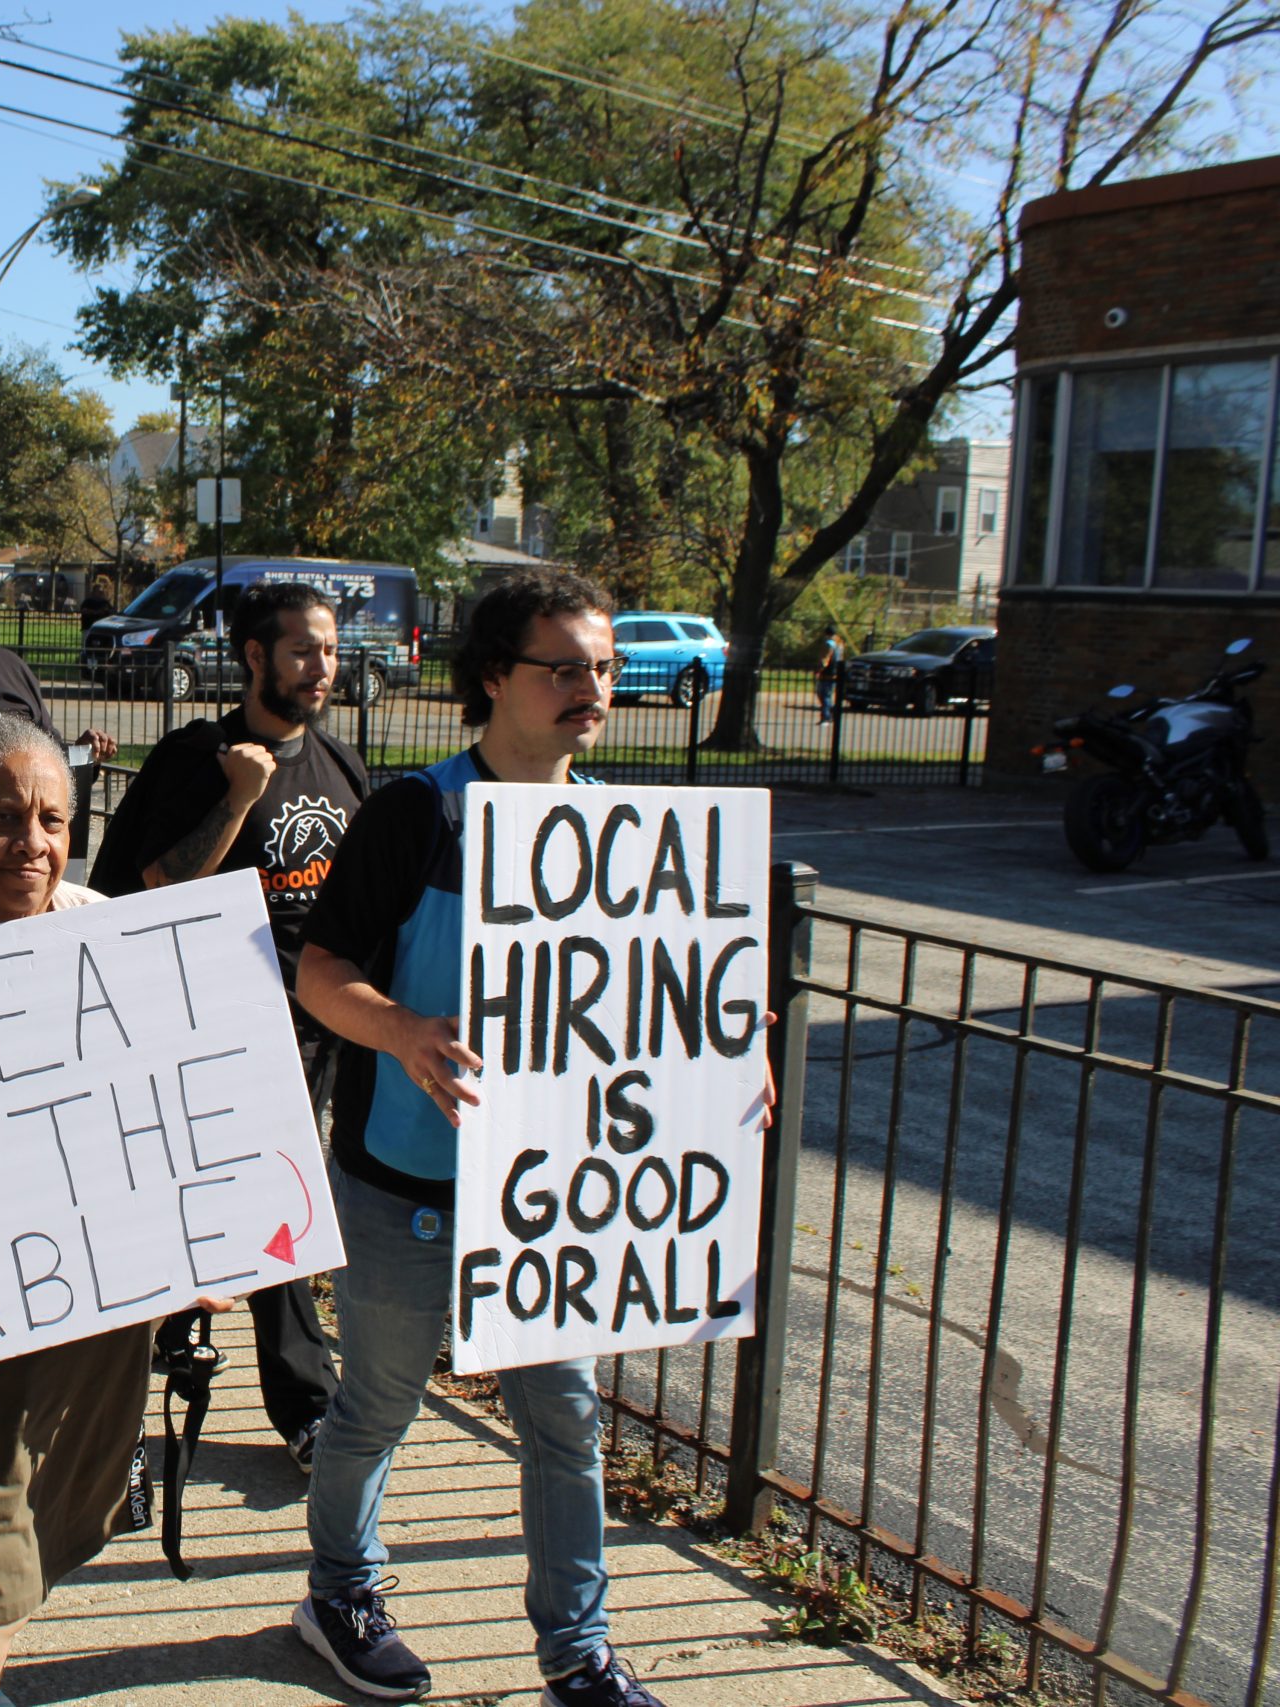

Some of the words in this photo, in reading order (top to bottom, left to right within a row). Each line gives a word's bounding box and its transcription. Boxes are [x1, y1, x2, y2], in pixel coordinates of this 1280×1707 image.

[344, 581, 375, 598] 73
[480, 800, 751, 926] LOCAL
[467, 935, 760, 1078] HIRING
[7, 1047, 262, 1208] THE
[586, 1068, 654, 1155] IS
[500, 1147, 731, 1244] GOOD
[458, 1244, 599, 1343] FOR
[611, 1236, 743, 1334] ALL
[130, 1446, 145, 1492] Calvin
[130, 1490, 146, 1527] Klein
